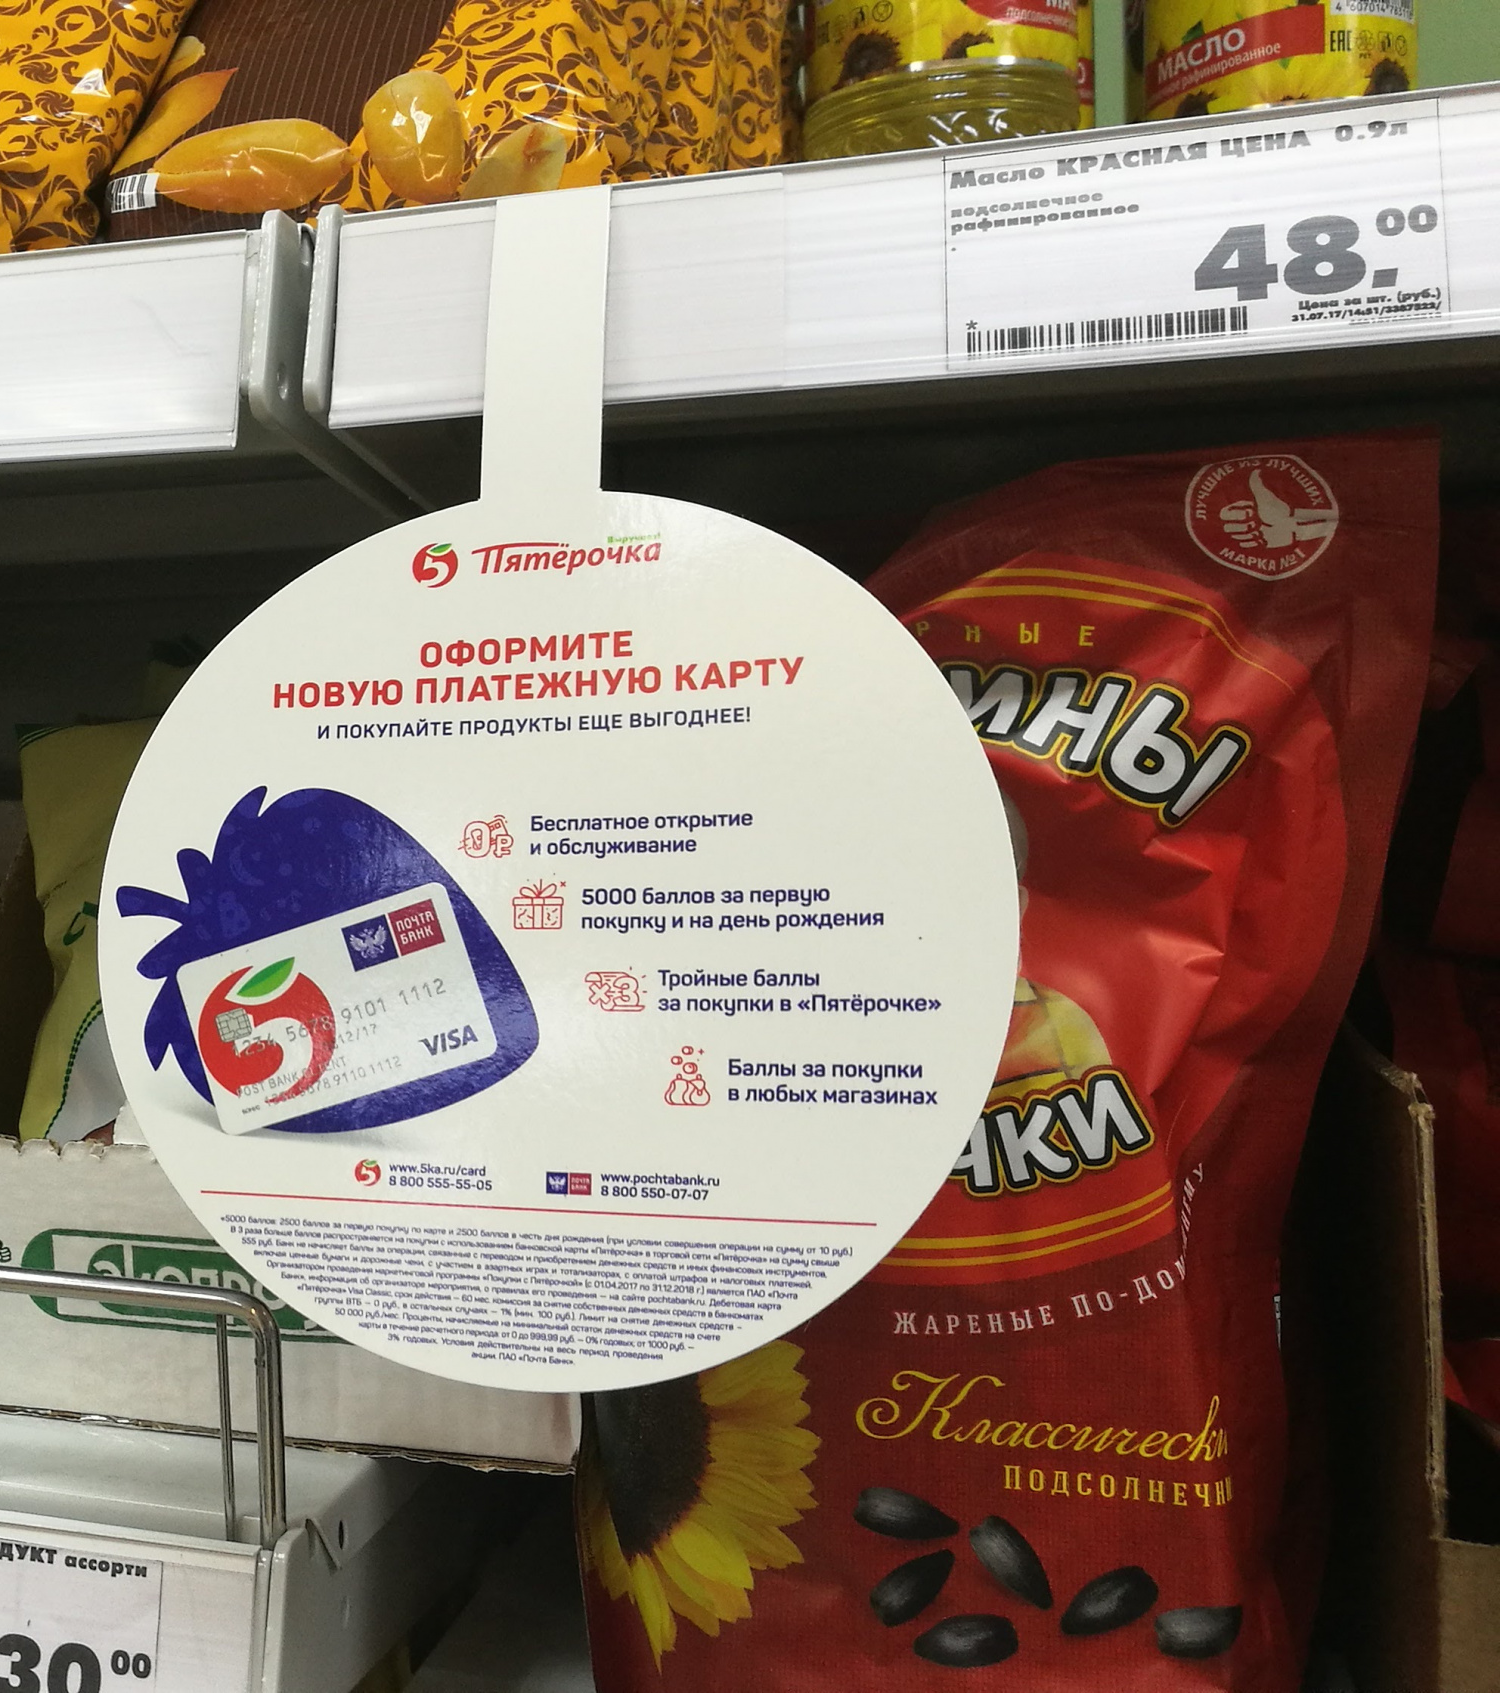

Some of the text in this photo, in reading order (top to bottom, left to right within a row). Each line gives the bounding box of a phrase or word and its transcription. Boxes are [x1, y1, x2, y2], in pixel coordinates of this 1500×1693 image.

[1158, 28, 1246, 84] МАСЛО
[949, 120, 1410, 189] Масло КРАСНАЯ ЦЕНА 0.9л
[950, 190, 1103, 218] подсолнечное
[950, 202, 1140, 236] рафинированное
[1375, 204, 1438, 237] 00
[1298, 299, 1339, 311] Цена
[1196, 464, 1234, 520] ЛУЧШИЕ
[1266, 459, 1324, 506] ЛУЧШИХ
[472, 541, 662, 576] Пятёрочка
[1219, 548, 1276, 571] МАРКА
[420, 630, 633, 669] ОФОРМИТЕ
[273, 655, 804, 710] НОВУЮ ПЛАТЕЖНУЮ КАРТУ
[317, 707, 751, 740] И ПОКУПАЙТЕ ПРОДУКТЫ ЕЩЕ ВЫГОДНЕЕ!
[530, 810, 753, 833] Бесплатное открытие
[530, 838, 698, 859] и обслуживание
[581, 886, 830, 908] 5000 баллов за первую
[396, 910, 435, 932] ПОЧТА
[581, 910, 884, 933] покупку и на день рождения
[400, 925, 434, 945] БАНК
[657, 968, 820, 993] Тройные баллы
[286, 1015, 334, 1042] 5678
[341, 997, 387, 1024] 9101
[399, 978, 446, 1006] 1112
[658, 994, 942, 1017] за покупки в «Пятёрочке»
[418, 1024, 478, 1056] VISA
[269, 1071, 298, 1089] BANK
[727, 1058, 923, 1082] Баллы за покупки
[727, 1084, 938, 1106] в любых магазинах
[389, 1162, 486, 1178] www.5ka.ru/card
[601, 1171, 720, 1188] www.pochtabank.ru
[389, 1176, 493, 1192] 8 800 555-55-05
[601, 1186, 709, 1201] 8 800 550-07-07
[279, 1217, 300, 1226] 2500
[893, 1304, 1055, 1335] ЖАРЕНЫЕ
[65, 1554, 148, 1578] ассорти
[110, 1649, 151, 1679] 00
